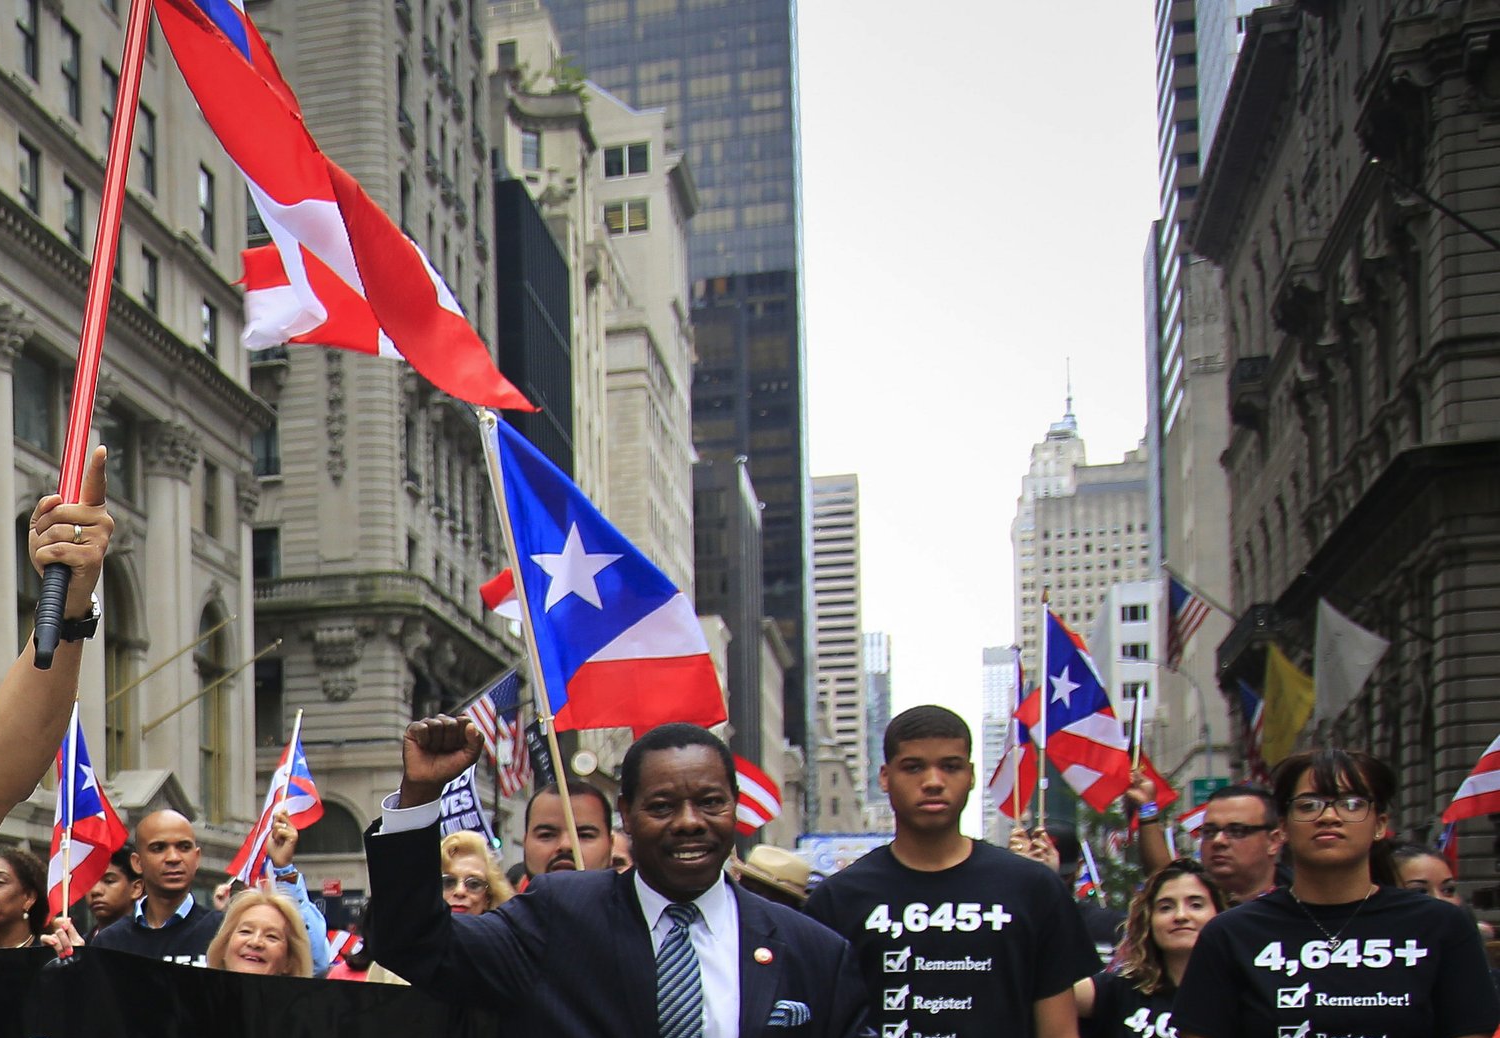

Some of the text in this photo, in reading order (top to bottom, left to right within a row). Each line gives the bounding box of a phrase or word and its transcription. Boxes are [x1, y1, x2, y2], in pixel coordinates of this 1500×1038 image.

[865, 902, 1012, 939] 4,645+
[914, 955, 992, 971] Remember!
[1253, 939, 1428, 977] 4,645+
[912, 996, 972, 1014] Register!
[1315, 992, 1410, 1007] Remember!
